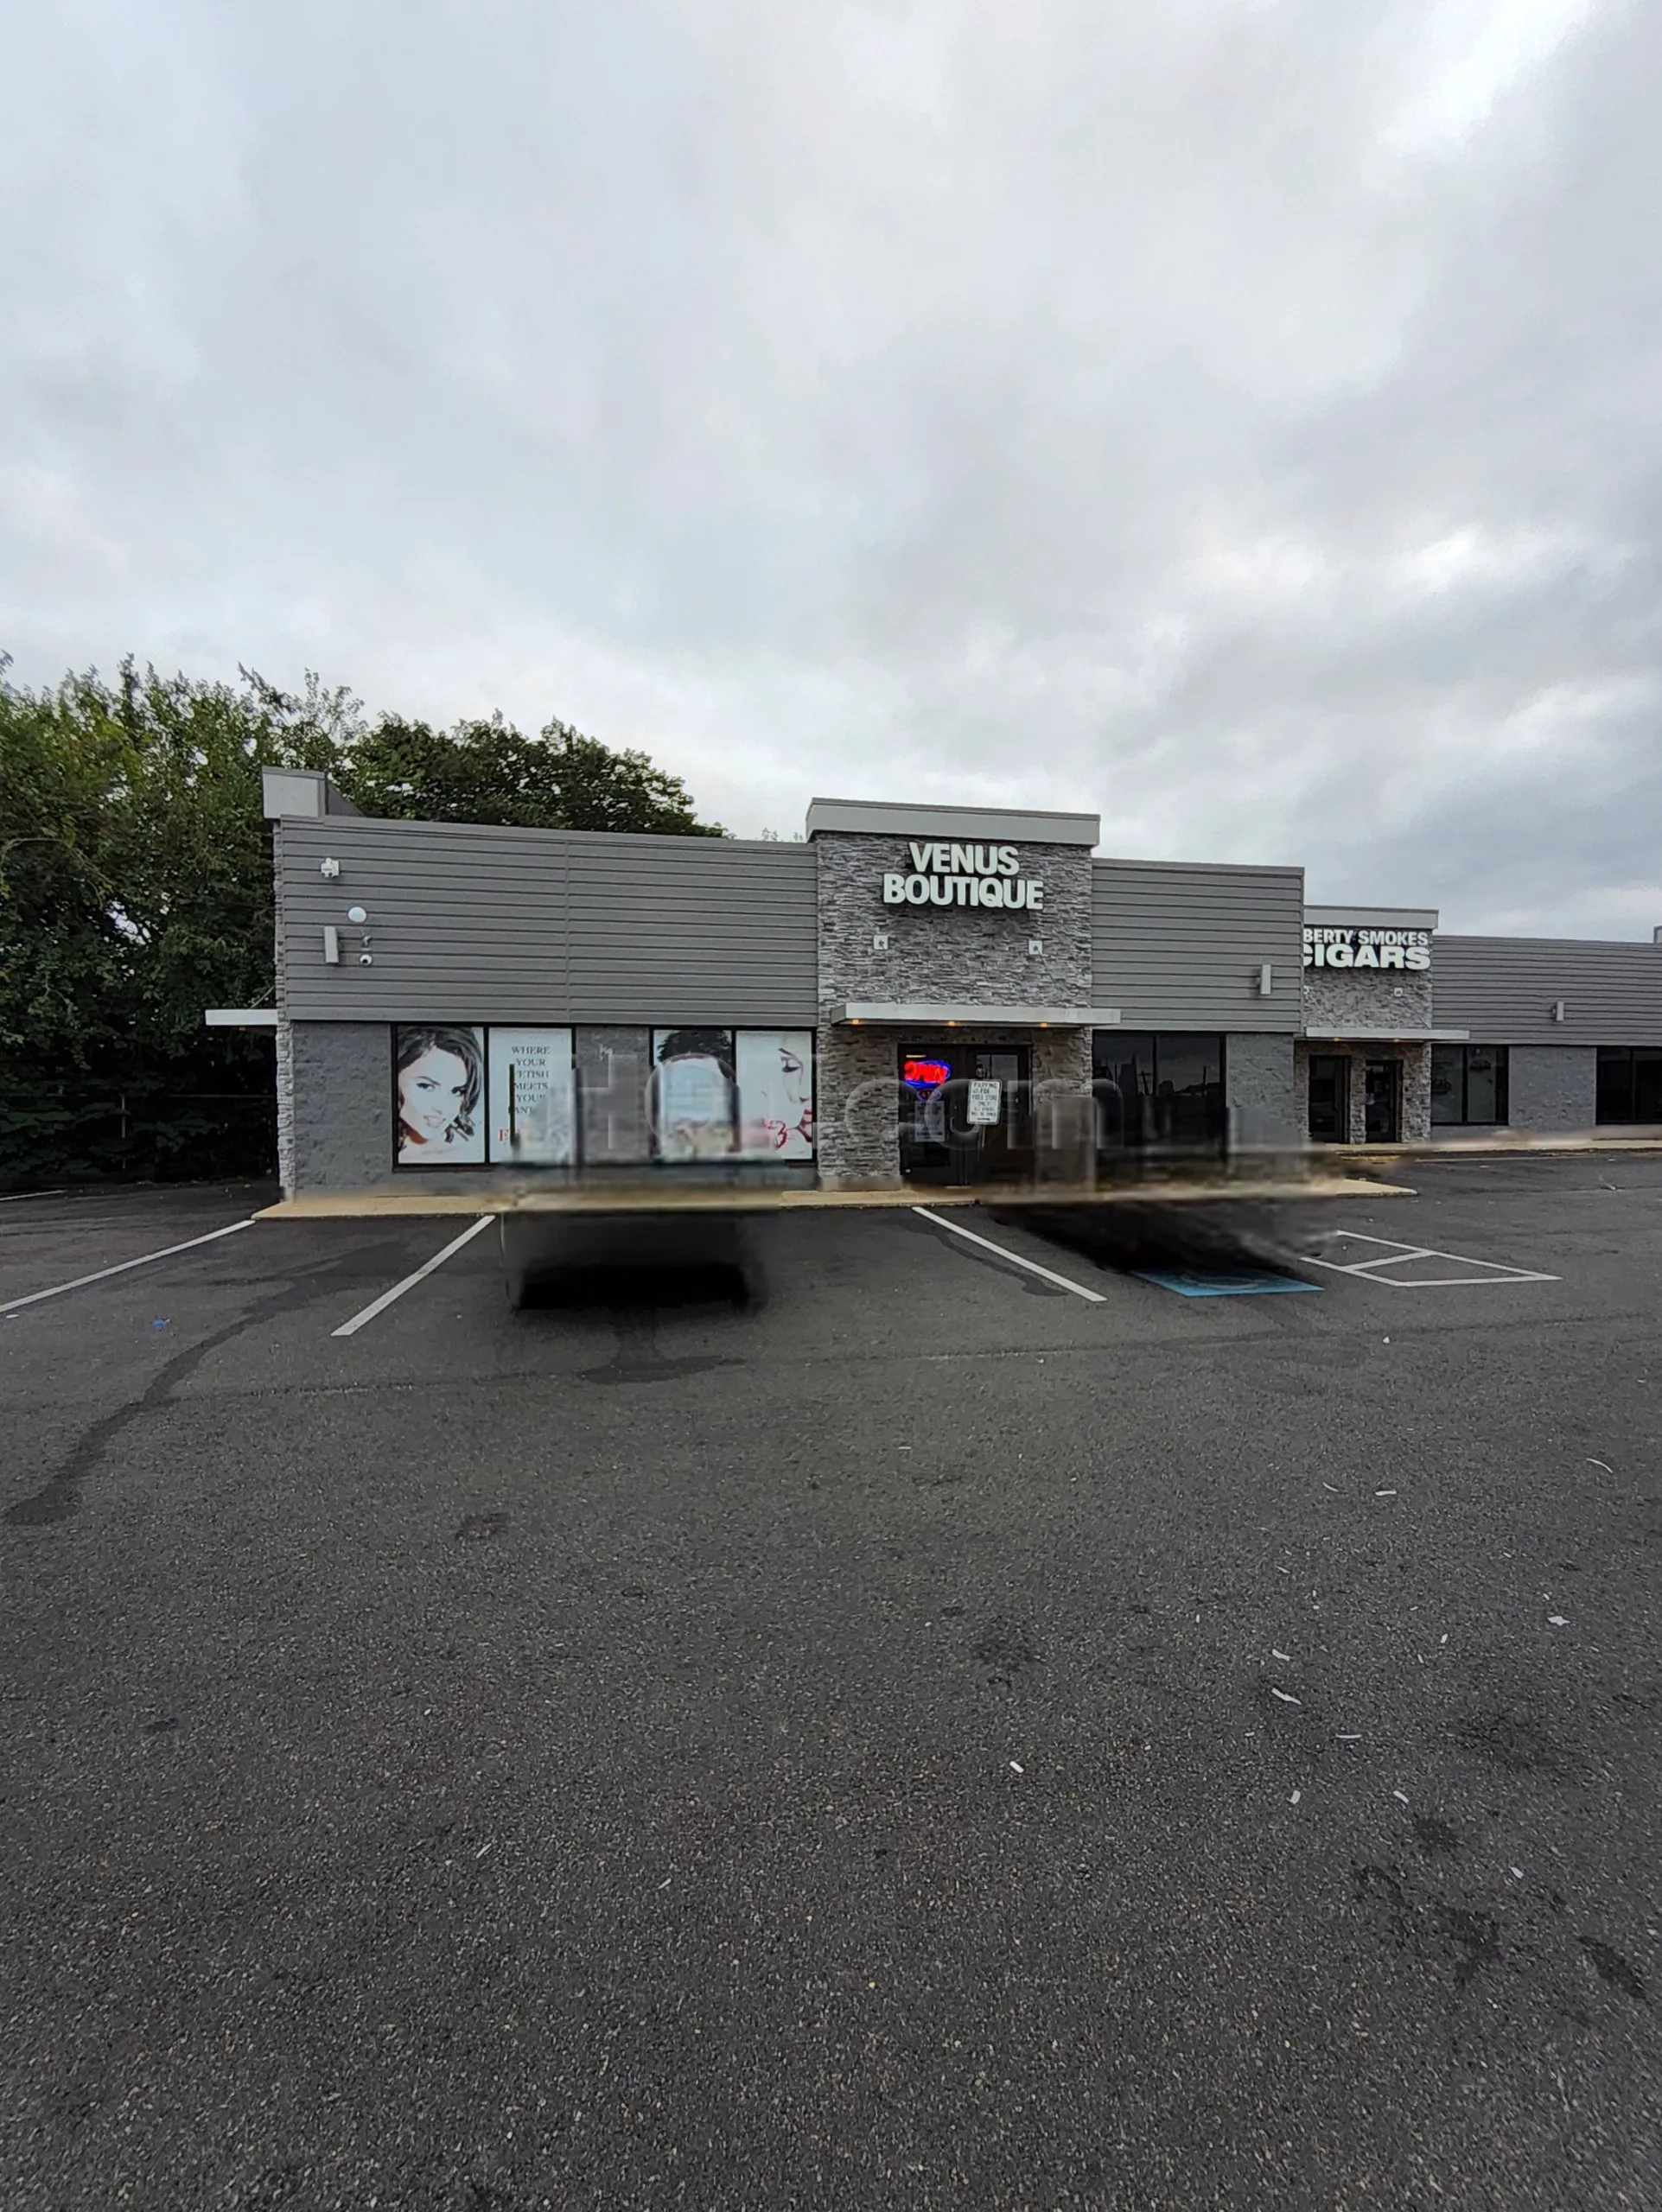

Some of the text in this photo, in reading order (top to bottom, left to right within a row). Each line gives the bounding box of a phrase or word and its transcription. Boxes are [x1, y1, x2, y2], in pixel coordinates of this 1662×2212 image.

[909, 842, 1020, 876] VENUS
[883, 874, 1044, 910] BOUTIQUE
[1303, 928, 1429, 946] BERTY SMOKES
[512, 1046, 551, 1054] WHERE
